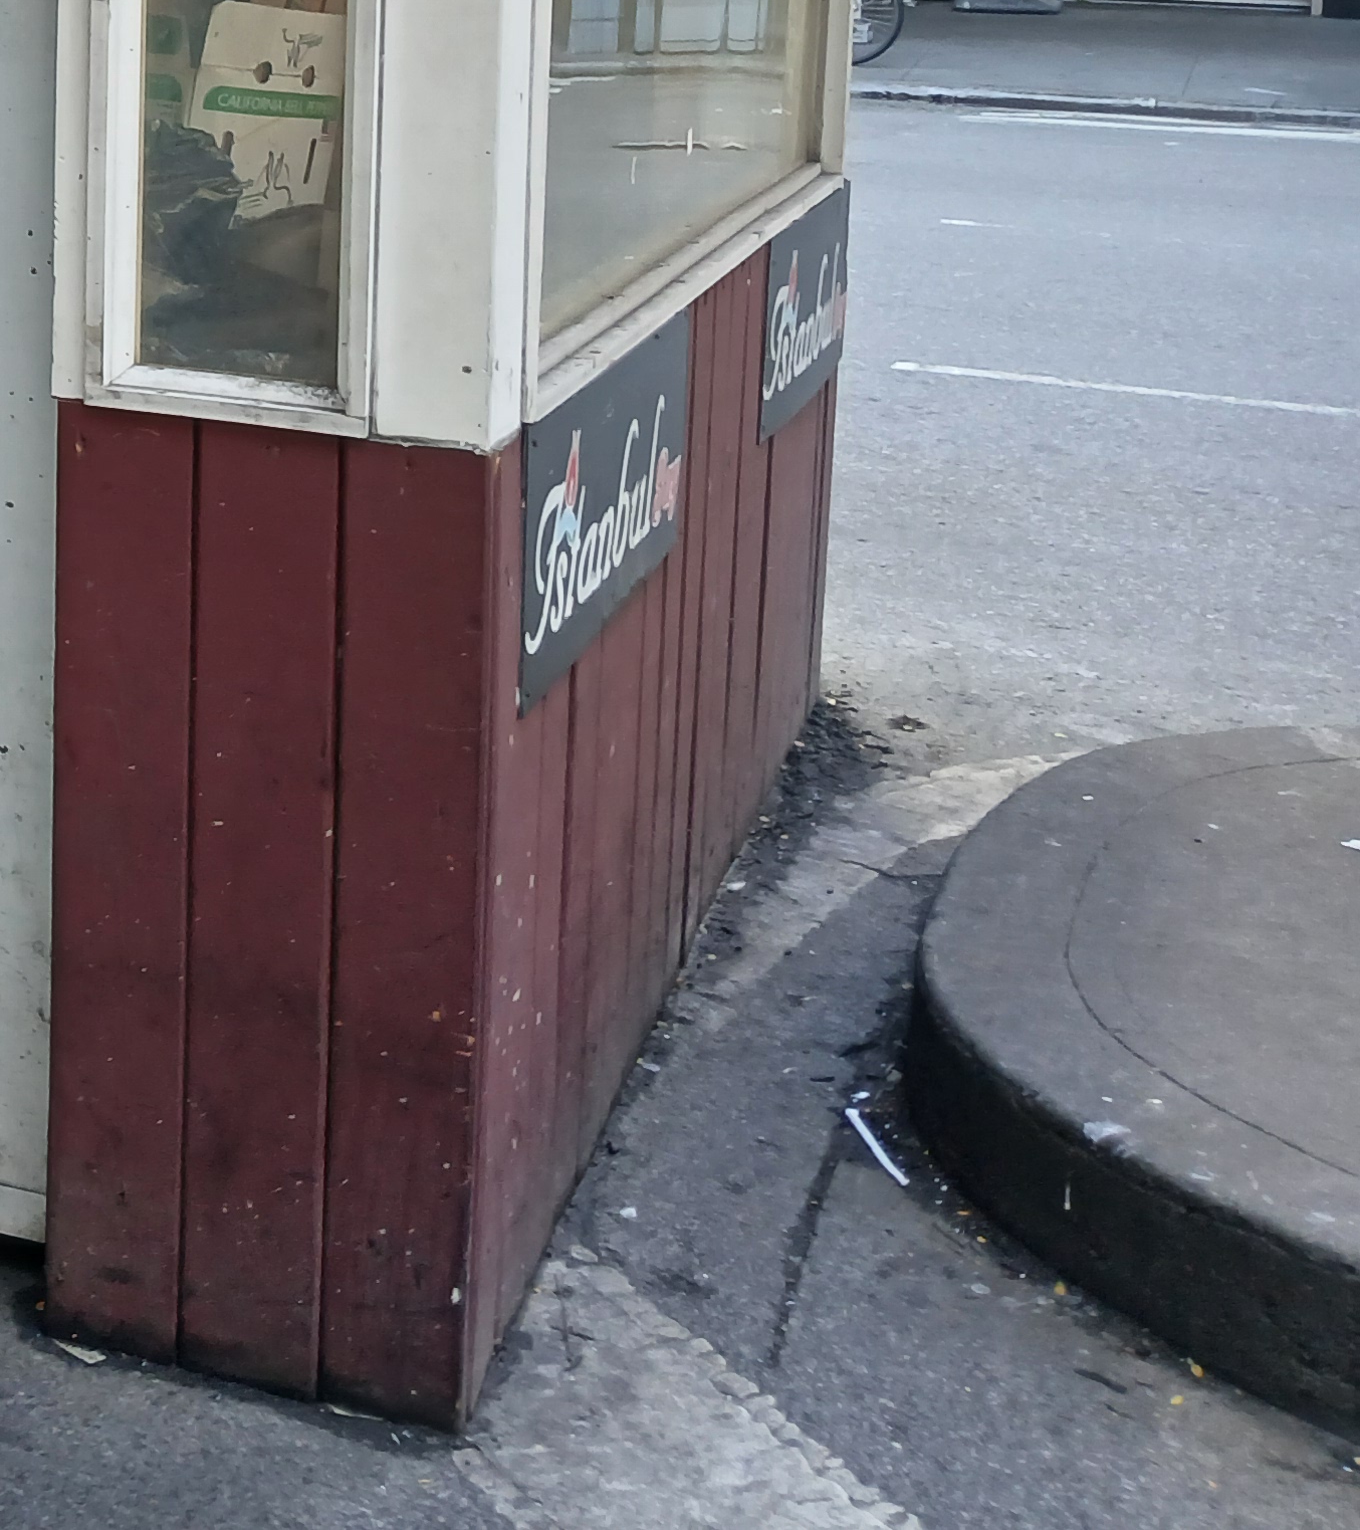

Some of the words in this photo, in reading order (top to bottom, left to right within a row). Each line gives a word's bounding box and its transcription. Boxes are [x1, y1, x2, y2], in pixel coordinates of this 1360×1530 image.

[217, 92, 283, 115] CALIFORNIA
[762, 242, 841, 401] Istanbul
[524, 394, 666, 656] Istanbul
